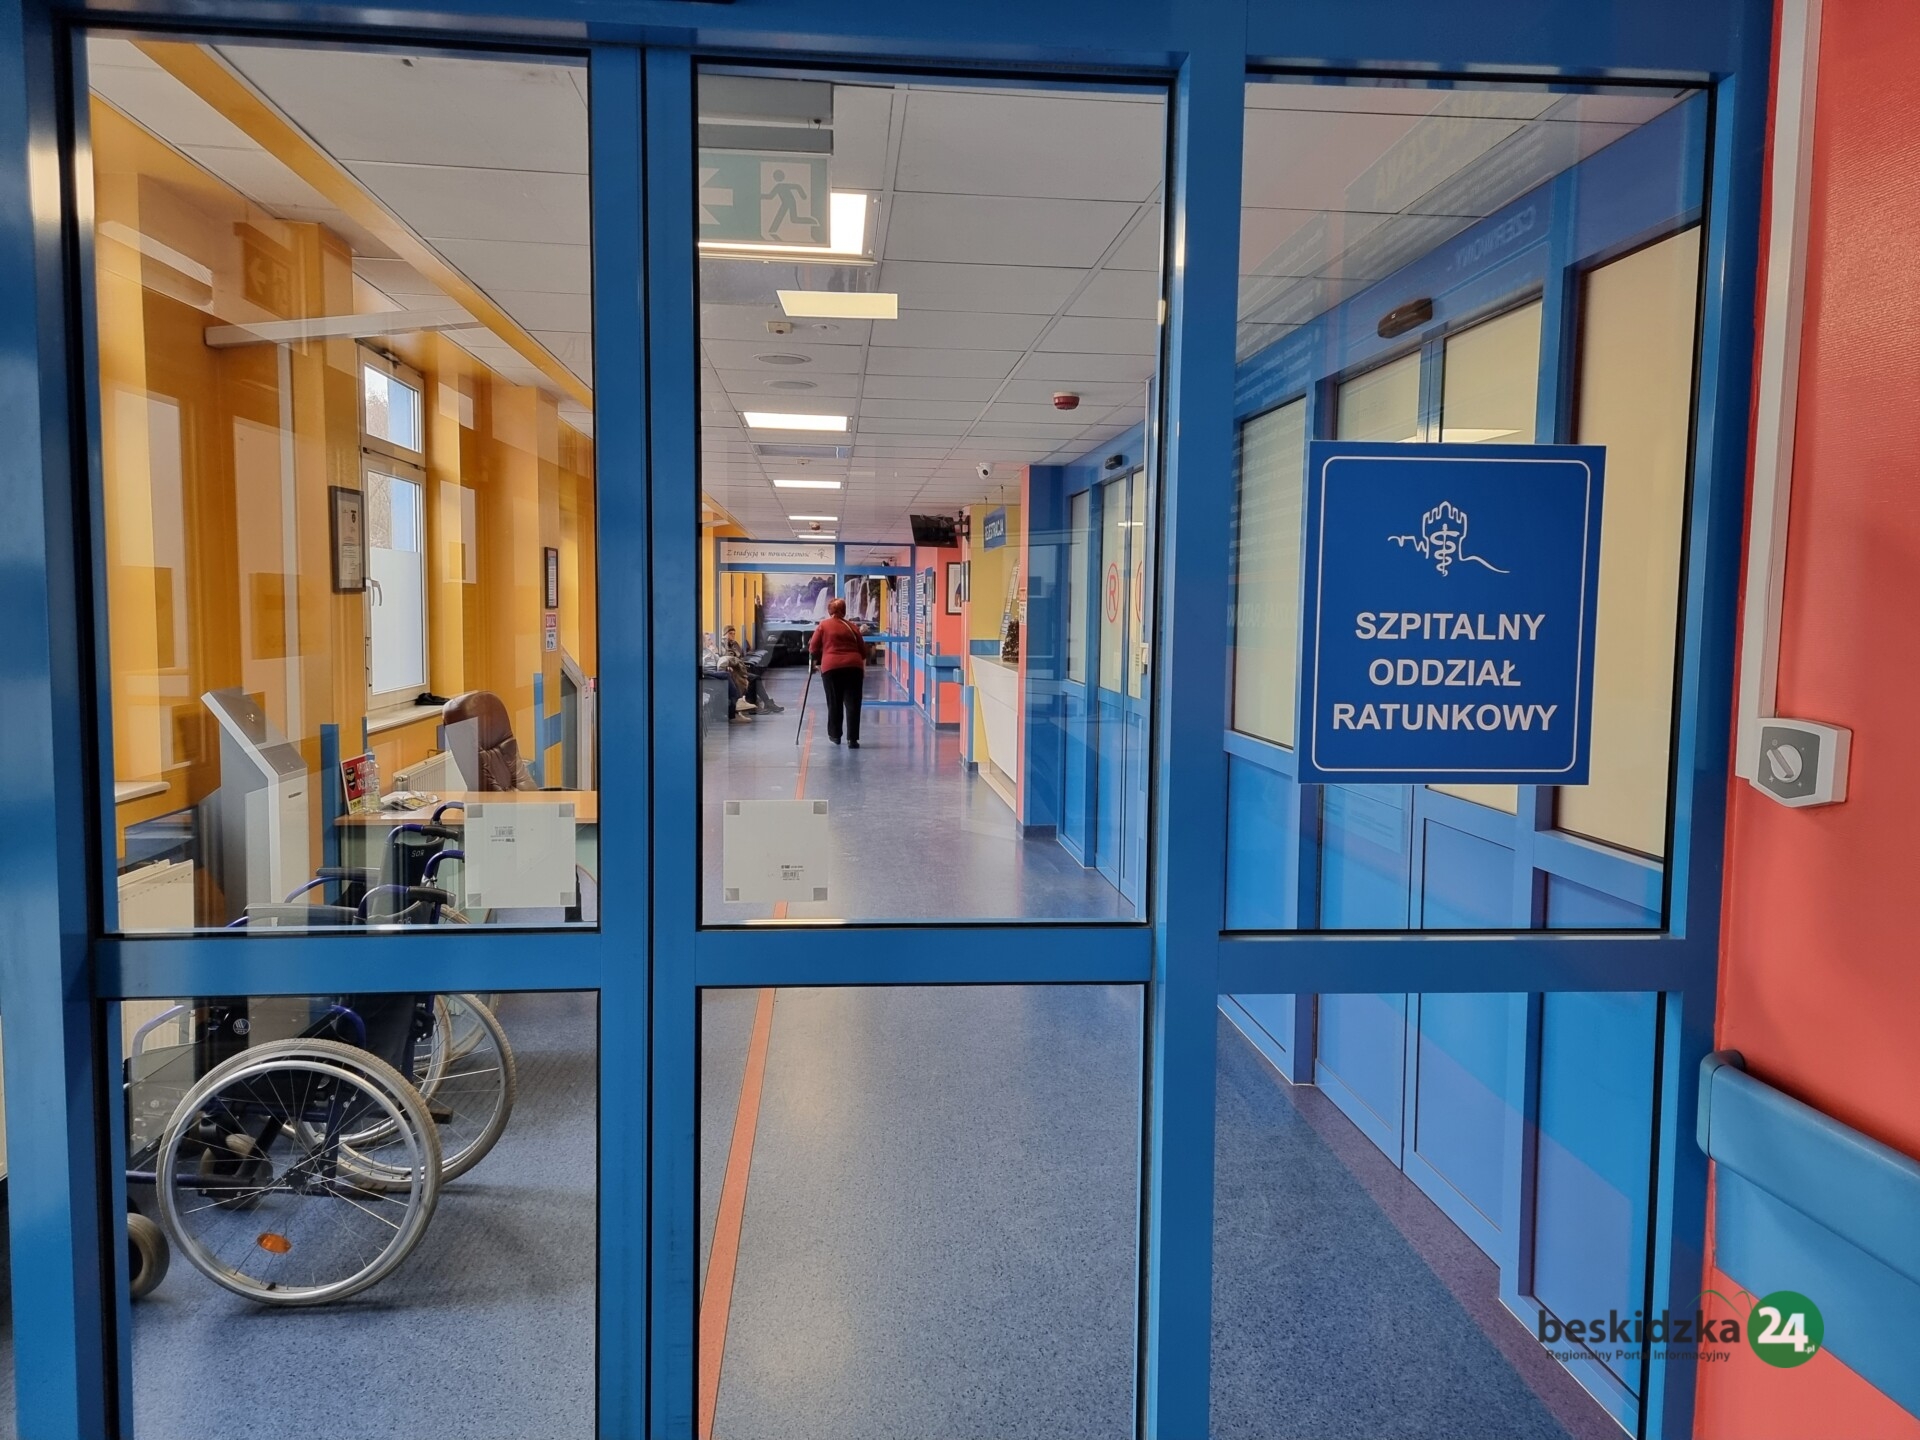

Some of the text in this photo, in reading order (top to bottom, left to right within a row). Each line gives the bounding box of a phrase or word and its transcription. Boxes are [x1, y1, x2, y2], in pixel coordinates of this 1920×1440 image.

[1355, 612, 1546, 641] SZPITALNY
[1368, 658, 1521, 687] ODDZIAŁ
[1333, 703, 1558, 731] RATUNKOWY
[411, 849, 425, 858] SOR
